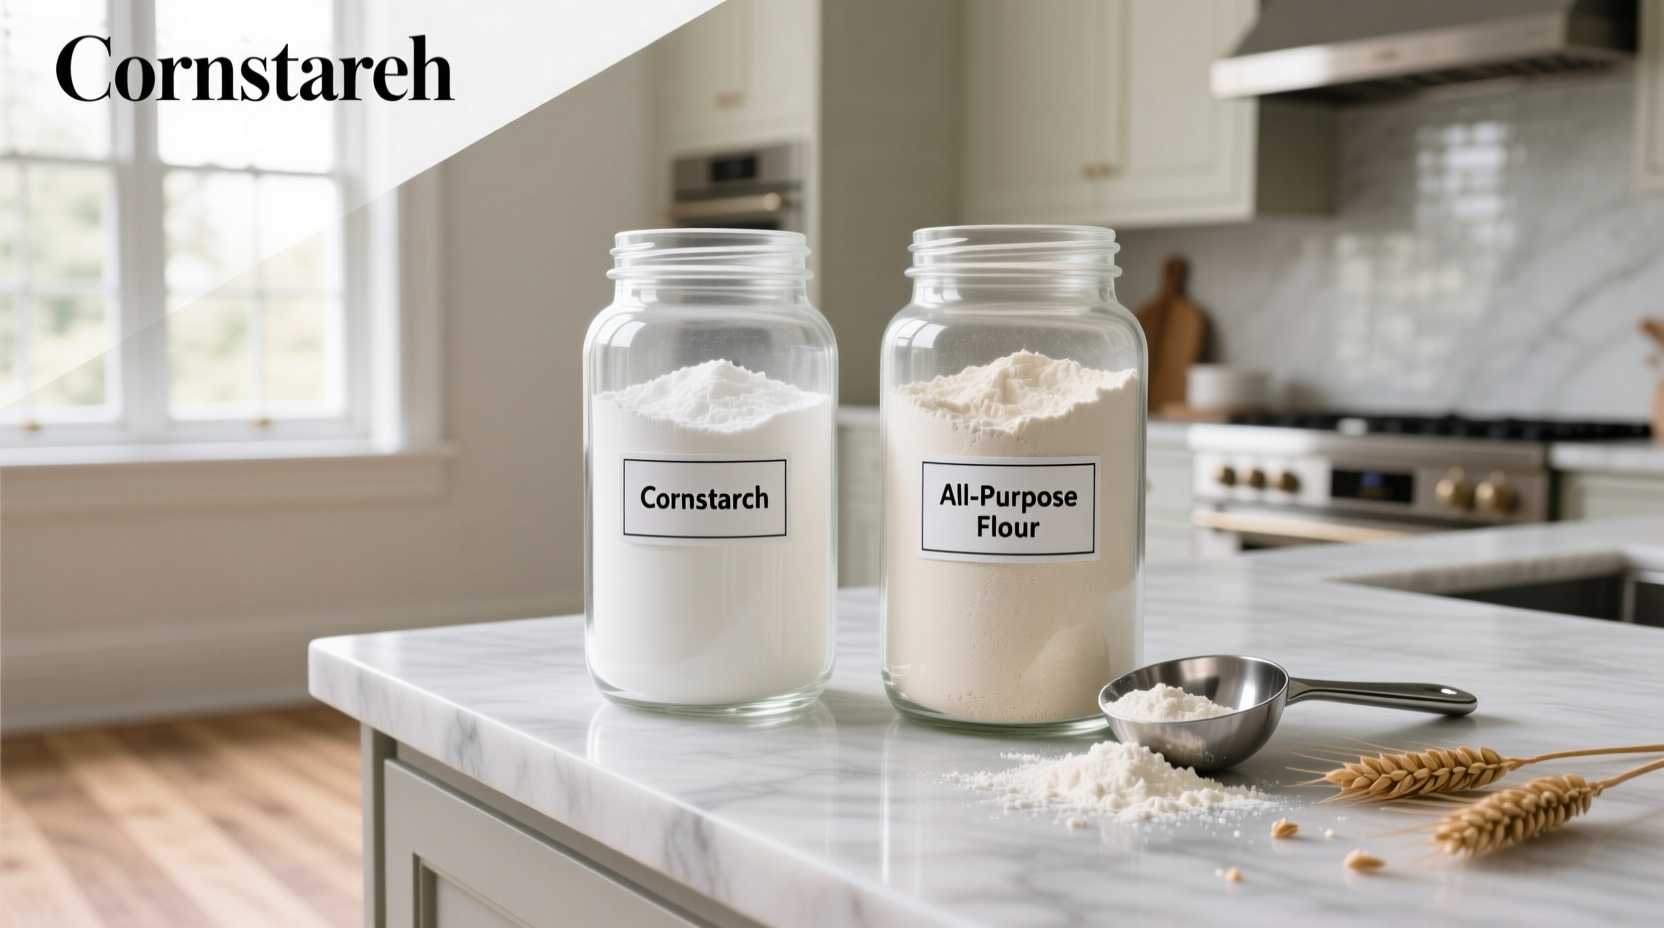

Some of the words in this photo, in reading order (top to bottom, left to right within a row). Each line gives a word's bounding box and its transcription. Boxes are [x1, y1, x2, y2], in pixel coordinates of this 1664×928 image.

[640, 485, 769, 510] Cornstarch
[939, 483, 1078, 514] All-Purpose
[977, 515, 1040, 538] Flour
